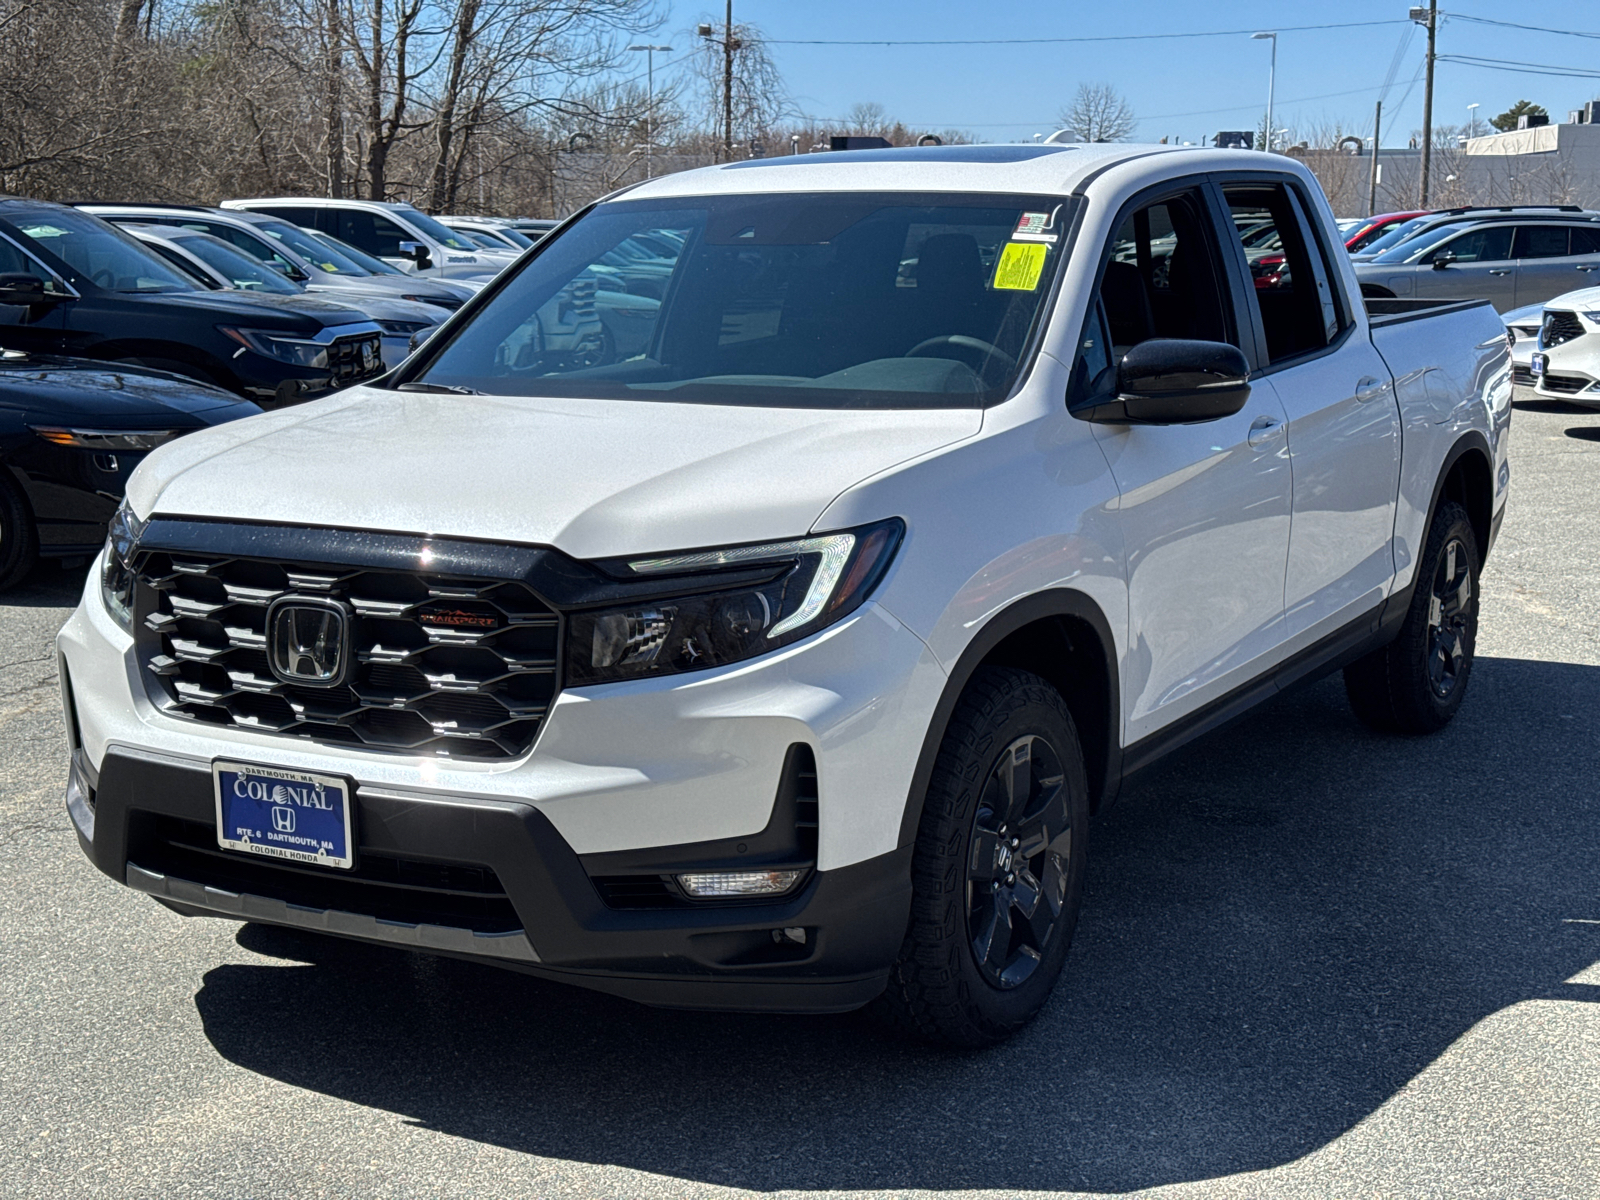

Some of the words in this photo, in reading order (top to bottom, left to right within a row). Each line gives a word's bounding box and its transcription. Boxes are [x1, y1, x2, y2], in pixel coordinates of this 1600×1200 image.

[420, 614, 495, 626] TRAILSPORT
[301, 775, 314, 783] MA
[234, 779, 333, 810] COLONIAL
[237, 827, 255, 838] RTE.
[255, 830, 262, 838] 6
[267, 832, 320, 849] DARTMOUTH,
[321, 840, 334, 850] MA
[250, 844, 288, 858] COLONIAL
[291, 852, 318, 863] HONDA
